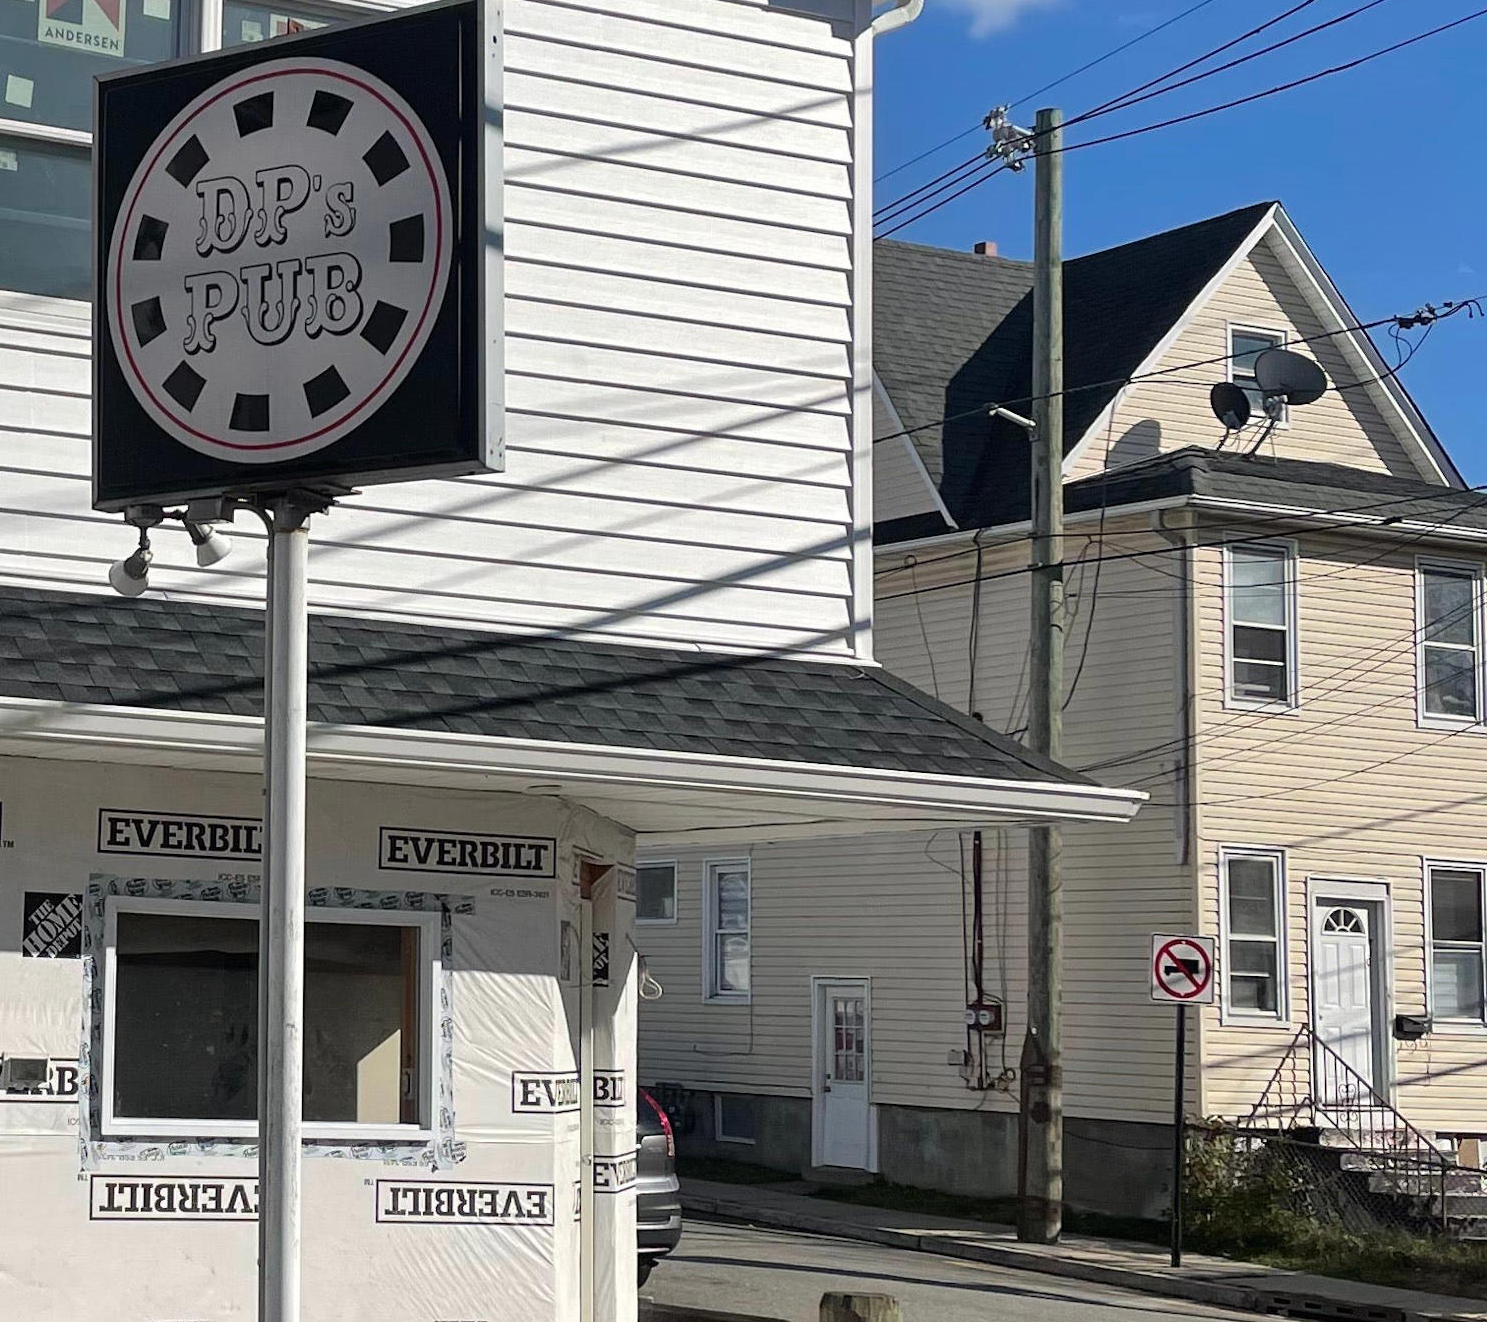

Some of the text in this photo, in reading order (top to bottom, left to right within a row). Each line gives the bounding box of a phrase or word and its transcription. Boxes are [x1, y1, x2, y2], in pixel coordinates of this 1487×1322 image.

[45, 27, 119, 50] ANDERSEN
[196, 164, 357, 258] DP's
[183, 252, 363, 355] PUB
[107, 817, 262, 854] EVERBIL
[387, 835, 548, 870] EVERBILT
[23, 893, 82, 957] HOME
[28, 899, 54, 925] THE
[45, 918, 82, 958] DEPOT
[99, 1182, 259, 1213] VERBILT
[384, 1186, 548, 1218] EVERBILT
